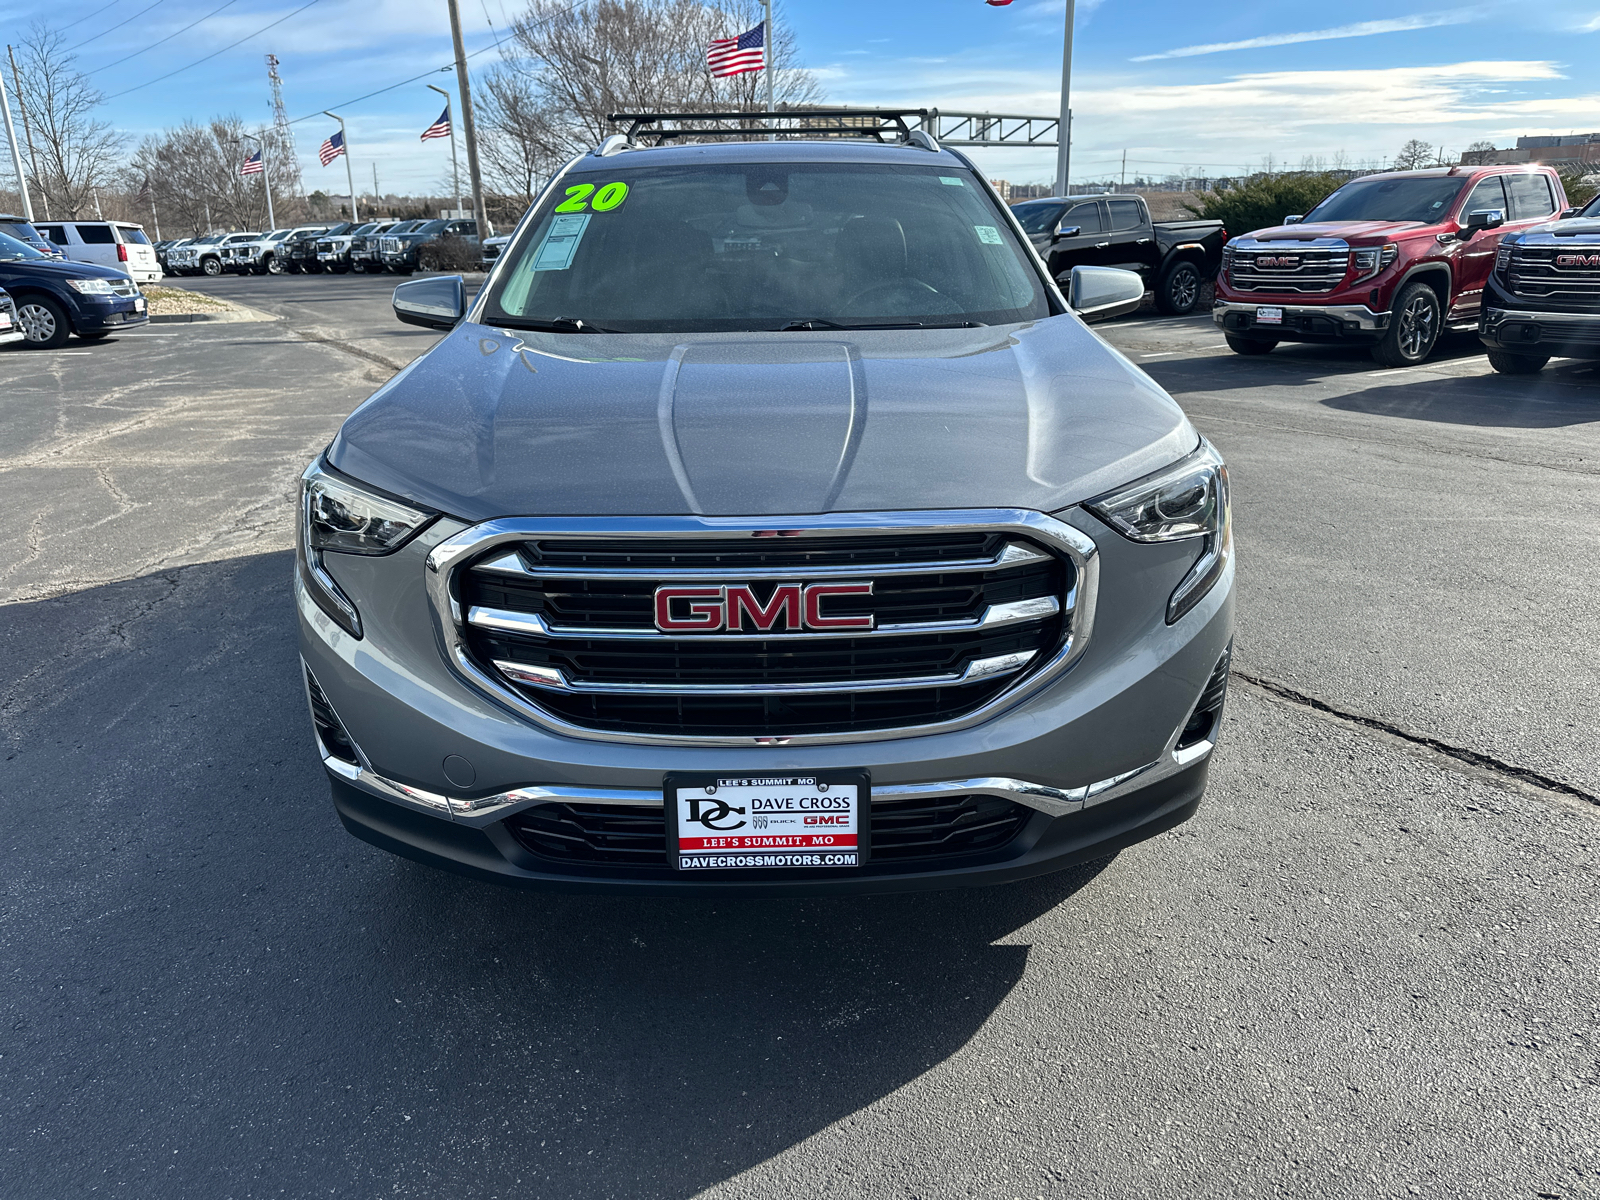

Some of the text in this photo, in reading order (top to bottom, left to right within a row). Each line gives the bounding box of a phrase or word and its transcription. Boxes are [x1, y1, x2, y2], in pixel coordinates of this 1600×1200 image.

[554, 182, 629, 213] 20
[1257, 256, 1299, 266] GMC
[1556, 254, 1600, 266] GM
[655, 582, 874, 632] GMC
[751, 778, 793, 786] SUMMIT
[752, 797, 850, 810] DAVE CROSS
[685, 799, 747, 831] DC
[803, 815, 850, 825] GMC
[703, 836, 834, 847] LEE'S SUMMIT, MO
[681, 854, 856, 868] DAVECROSSMOTORS.COM
